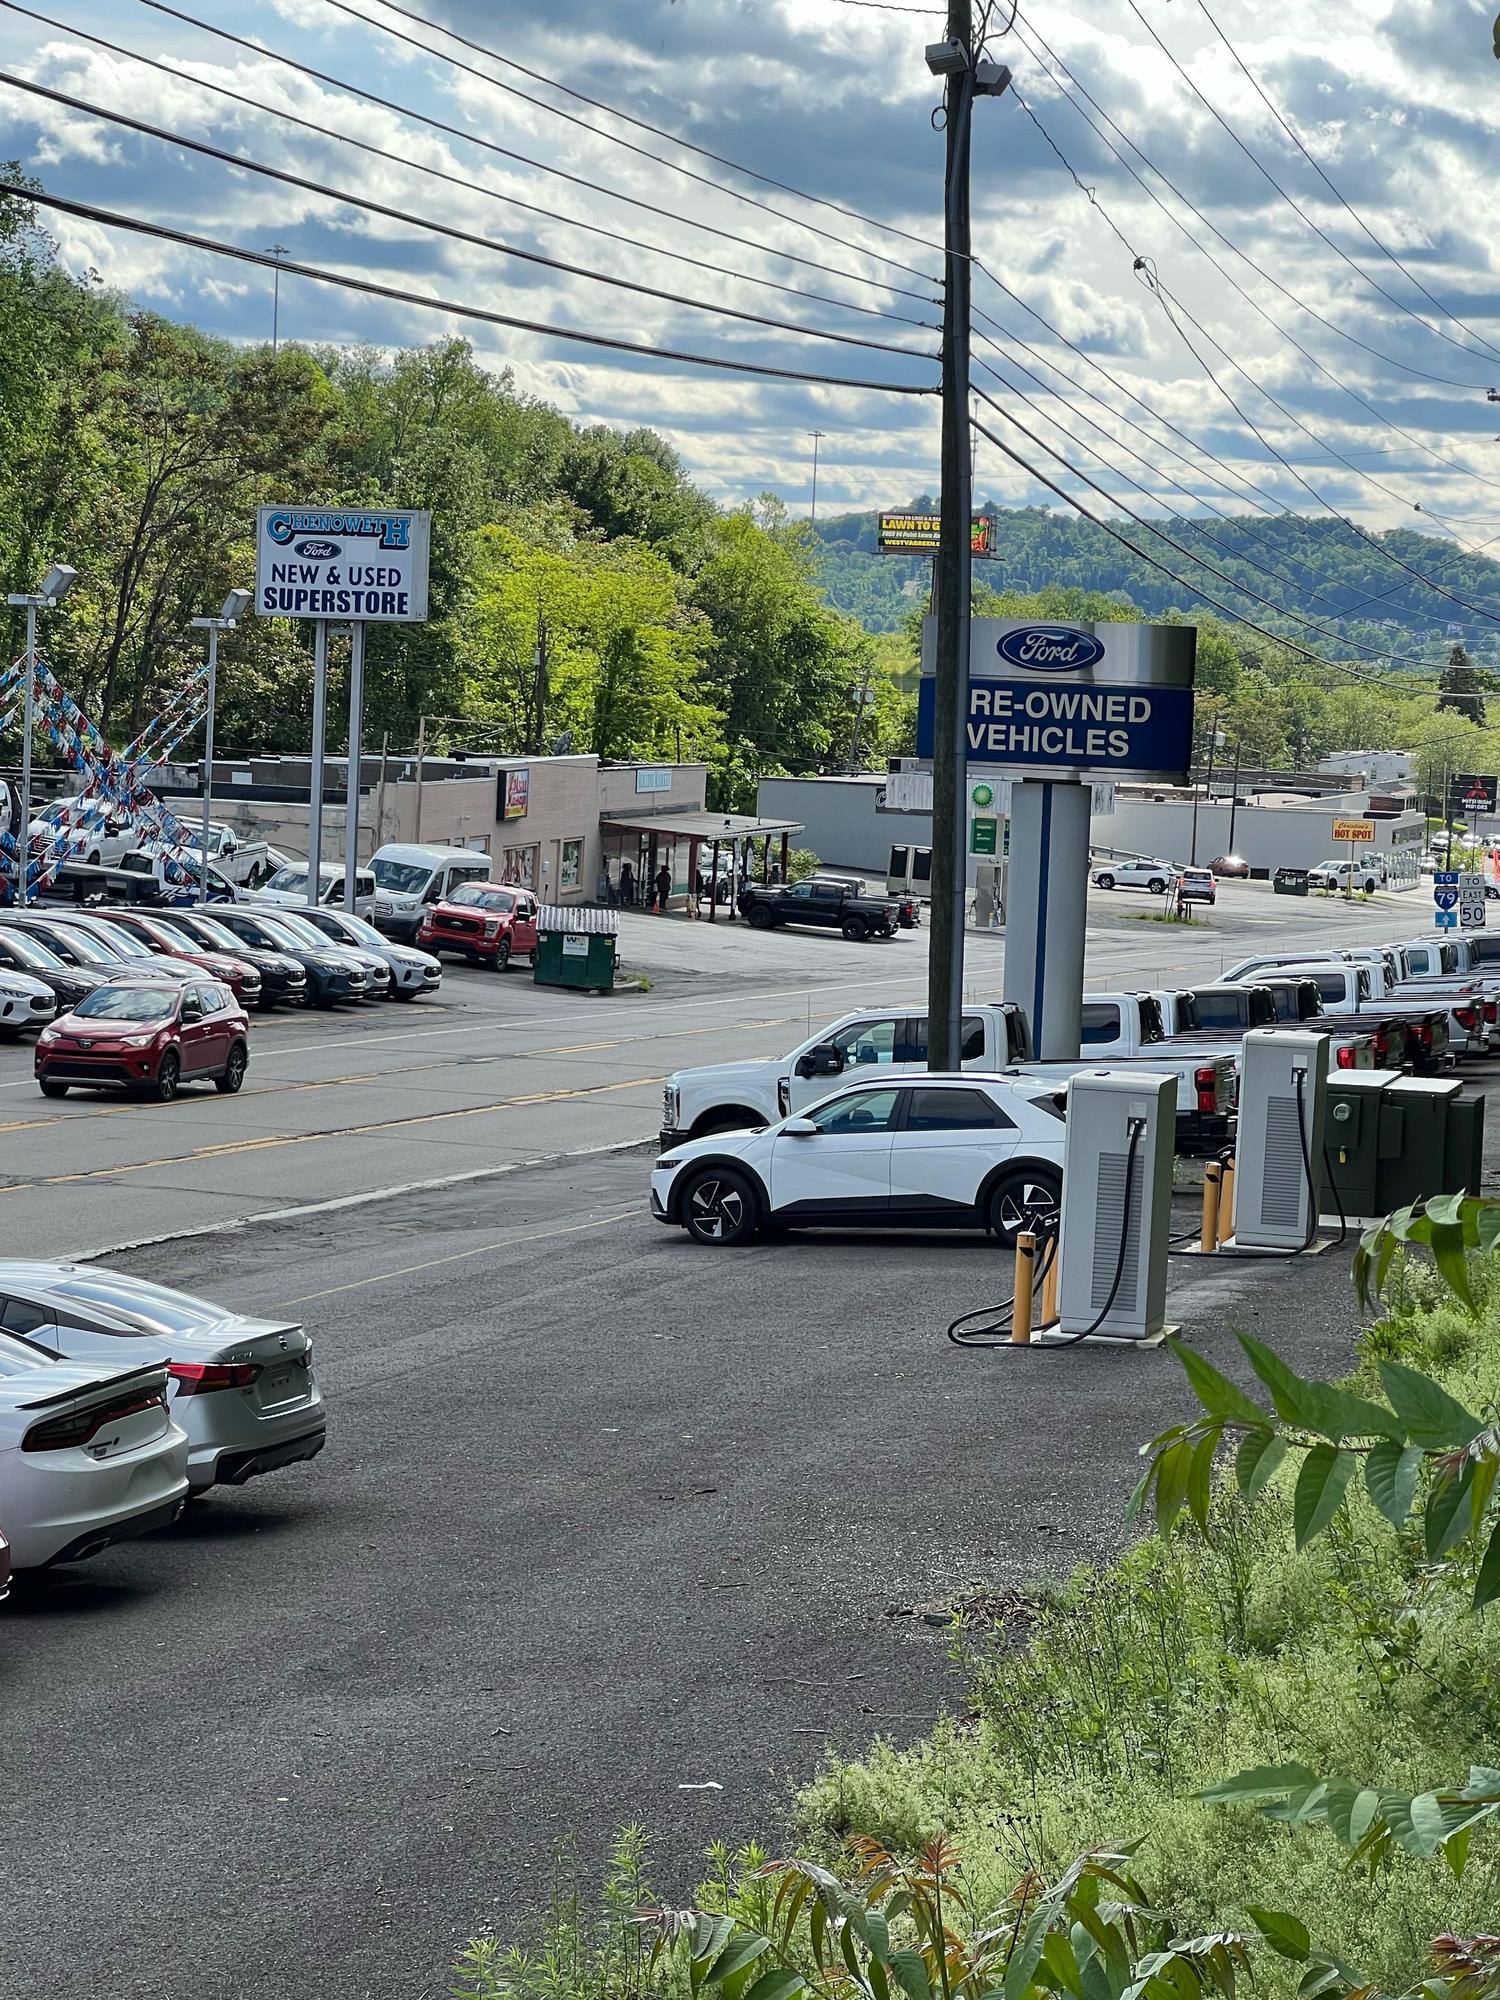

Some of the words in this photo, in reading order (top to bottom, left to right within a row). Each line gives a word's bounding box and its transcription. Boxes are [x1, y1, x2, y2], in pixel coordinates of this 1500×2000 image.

[267, 511, 411, 549] CHENOWETH
[882, 519, 914, 530] LAWN
[917, 520, 930, 530] TO
[932, 521, 940, 531] G
[303, 542, 333, 557] Ford
[271, 563, 320, 584] NEW
[326, 565, 341, 586] &
[349, 566, 401, 587] USED
[264, 587, 408, 615] SUPERSTORE
[1019, 633, 1079, 662] Ford
[970, 688, 1152, 723] RE-OWNED
[967, 723, 1129, 757] VEHICLES
[1334, 829, 1350, 839] HOT
[1351, 829, 1372, 840] SPOT
[1440, 874, 1452, 883] TO
[1465, 877, 1480, 885] TO
[1436, 893, 1456, 905] 79
[1462, 890, 1482, 899] EAST
[1462, 907, 1483, 921] 50
